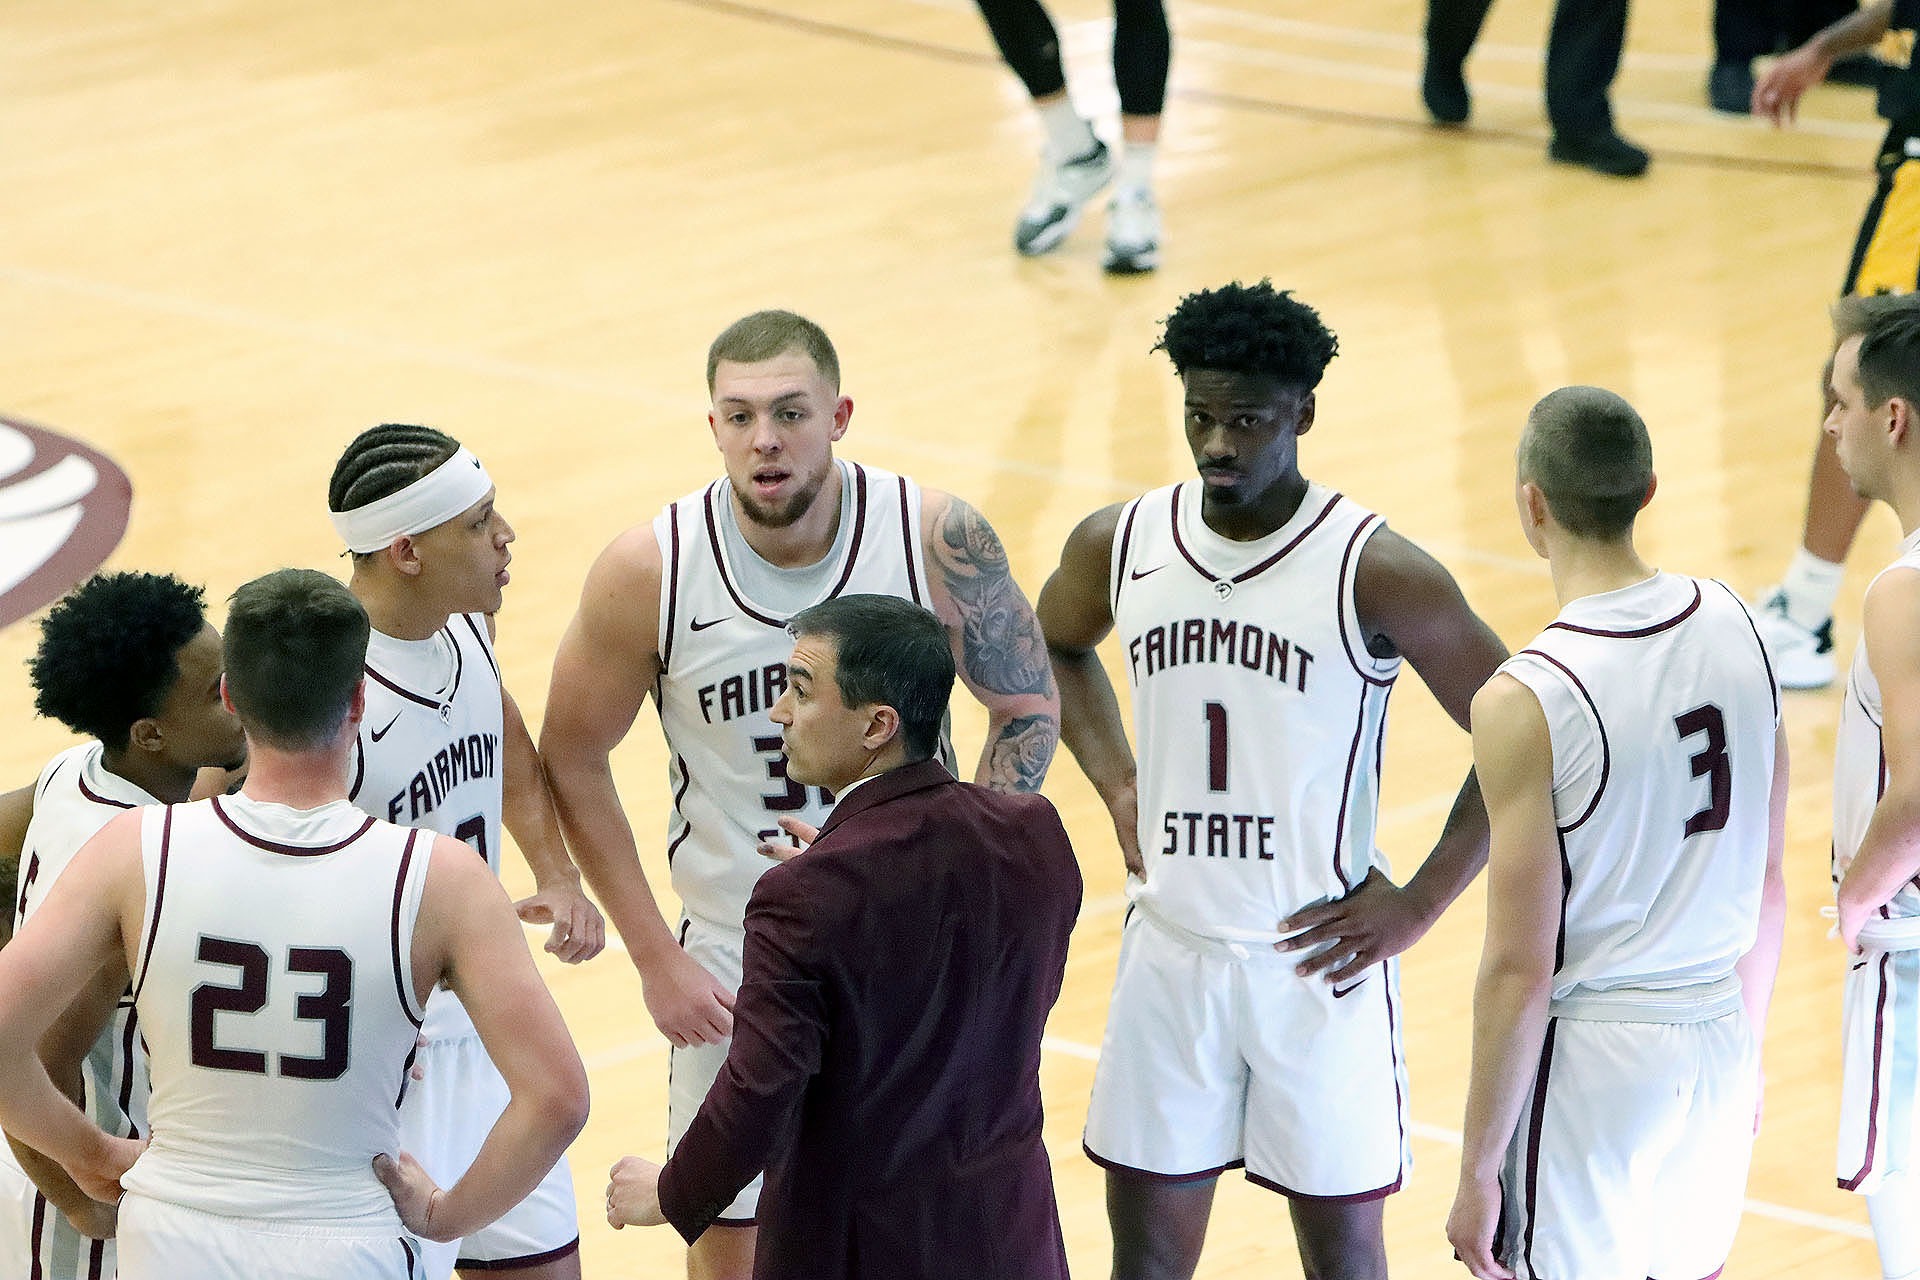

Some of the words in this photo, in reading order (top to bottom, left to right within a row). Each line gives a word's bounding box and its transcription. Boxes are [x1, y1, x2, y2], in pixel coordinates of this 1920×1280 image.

[1129, 617, 1315, 693] FAIRMONT
[388, 733, 498, 824] FAIRMON
[751, 736, 836, 812] 3
[1203, 699, 1231, 794] 1
[1672, 700, 1733, 840] 3
[1162, 811, 1275, 861] STATE
[188, 932, 356, 1082] 23
